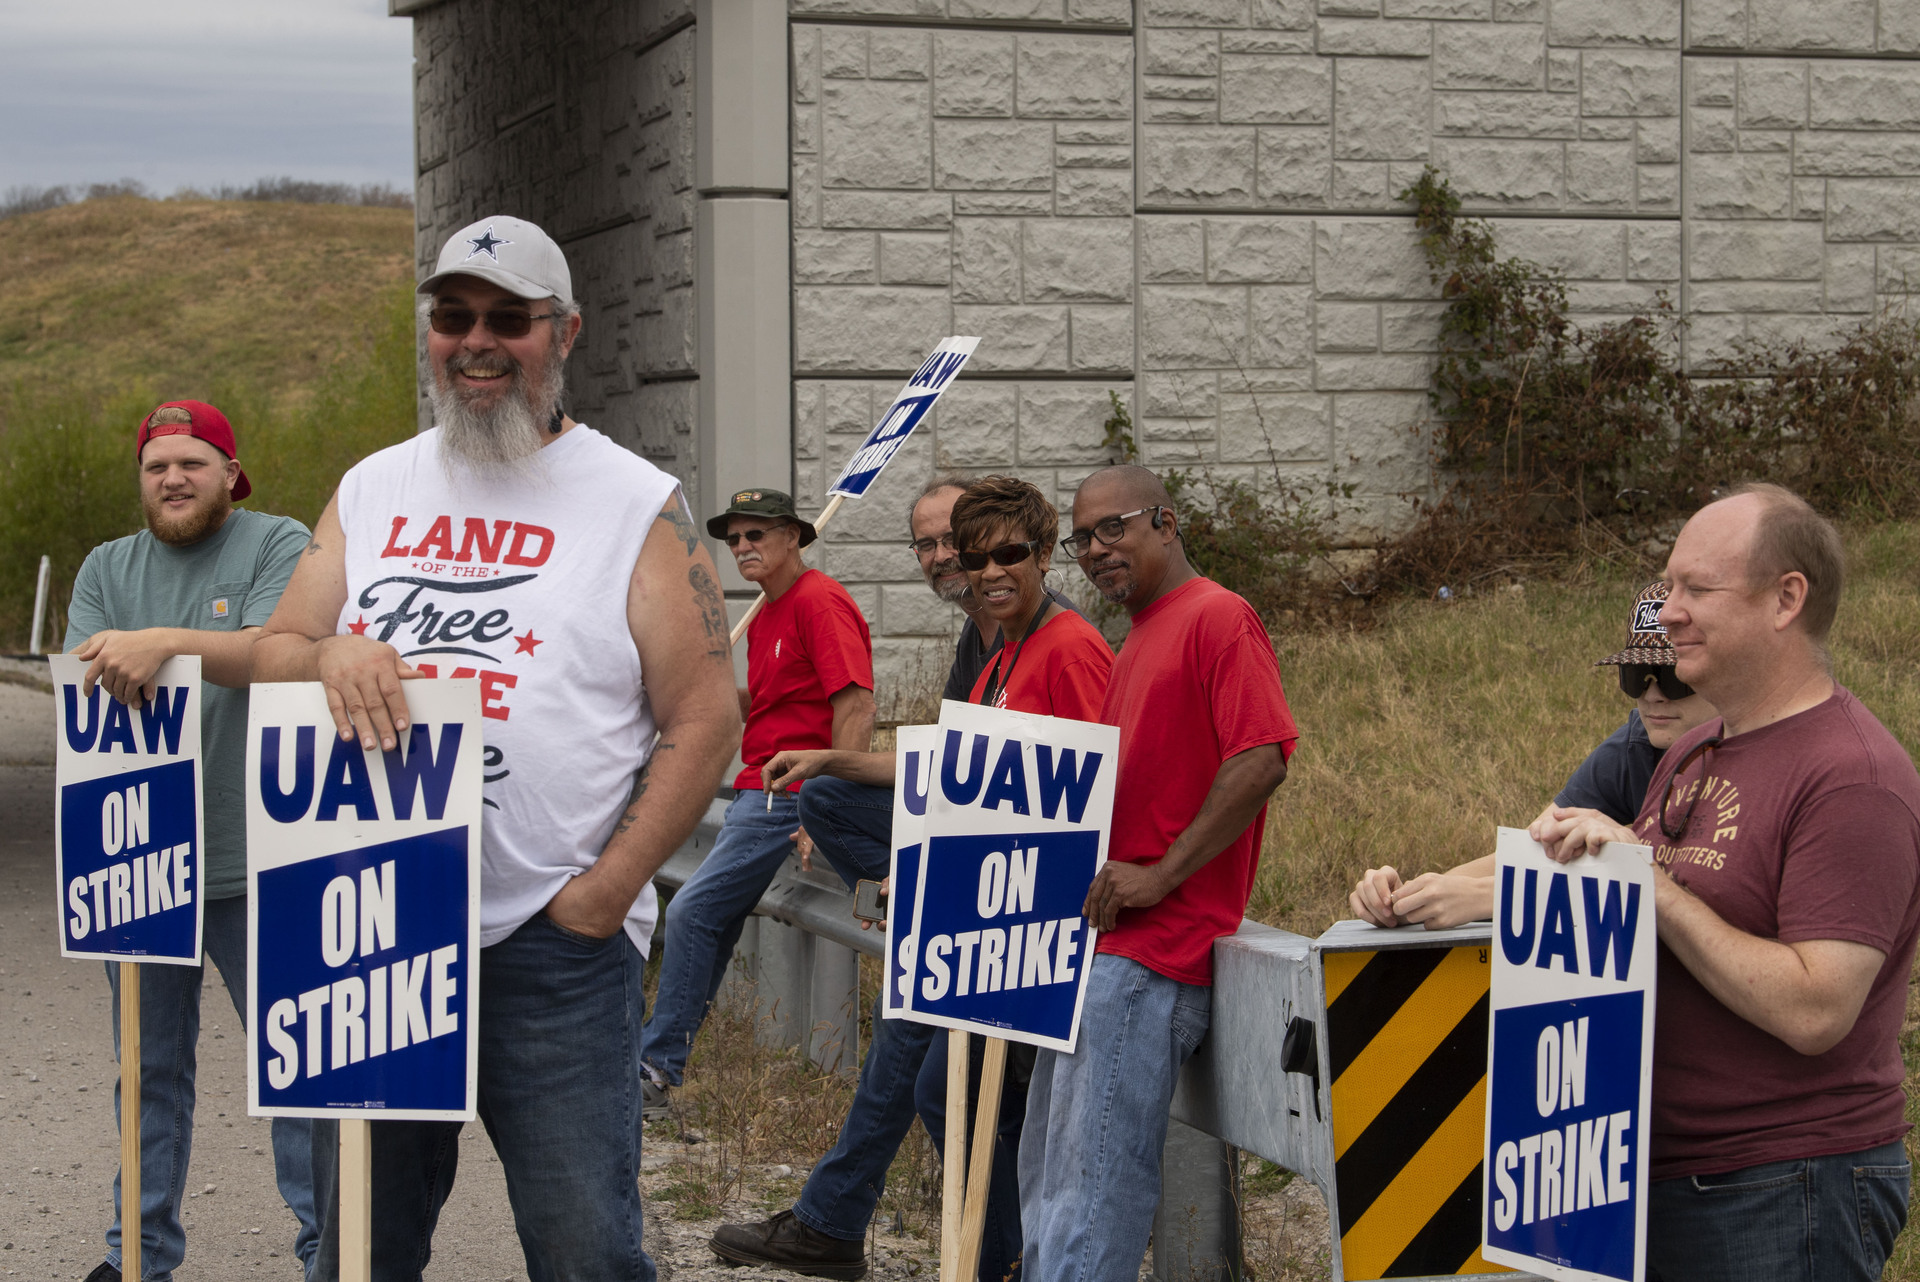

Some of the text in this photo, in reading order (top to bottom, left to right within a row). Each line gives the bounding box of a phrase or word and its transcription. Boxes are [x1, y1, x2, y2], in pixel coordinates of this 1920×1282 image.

[909, 351, 967, 390] UAW
[876, 402, 918, 440] ON
[380, 515, 555, 568] LAND
[421, 562, 489, 578] OF THE
[358, 574, 538, 645] Free
[63, 684, 190, 755] UAW
[260, 722, 464, 824] UAW
[940, 729, 1104, 824] UAW
[1644, 775, 1741, 843] AVENTURE
[102, 781, 150, 857] ON
[68, 841, 192, 941] STRIKE
[321, 859, 396, 969] ON
[977, 847, 1039, 919] ON
[921, 916, 1082, 1002] STRIKE
[1479, 948, 1488, 964] R
[1500, 864, 1642, 982] UAW
[266, 943, 459, 1090] STRIKE
[1536, 1016, 1590, 1118] ON
[1494, 1109, 1632, 1232] STRIKE
